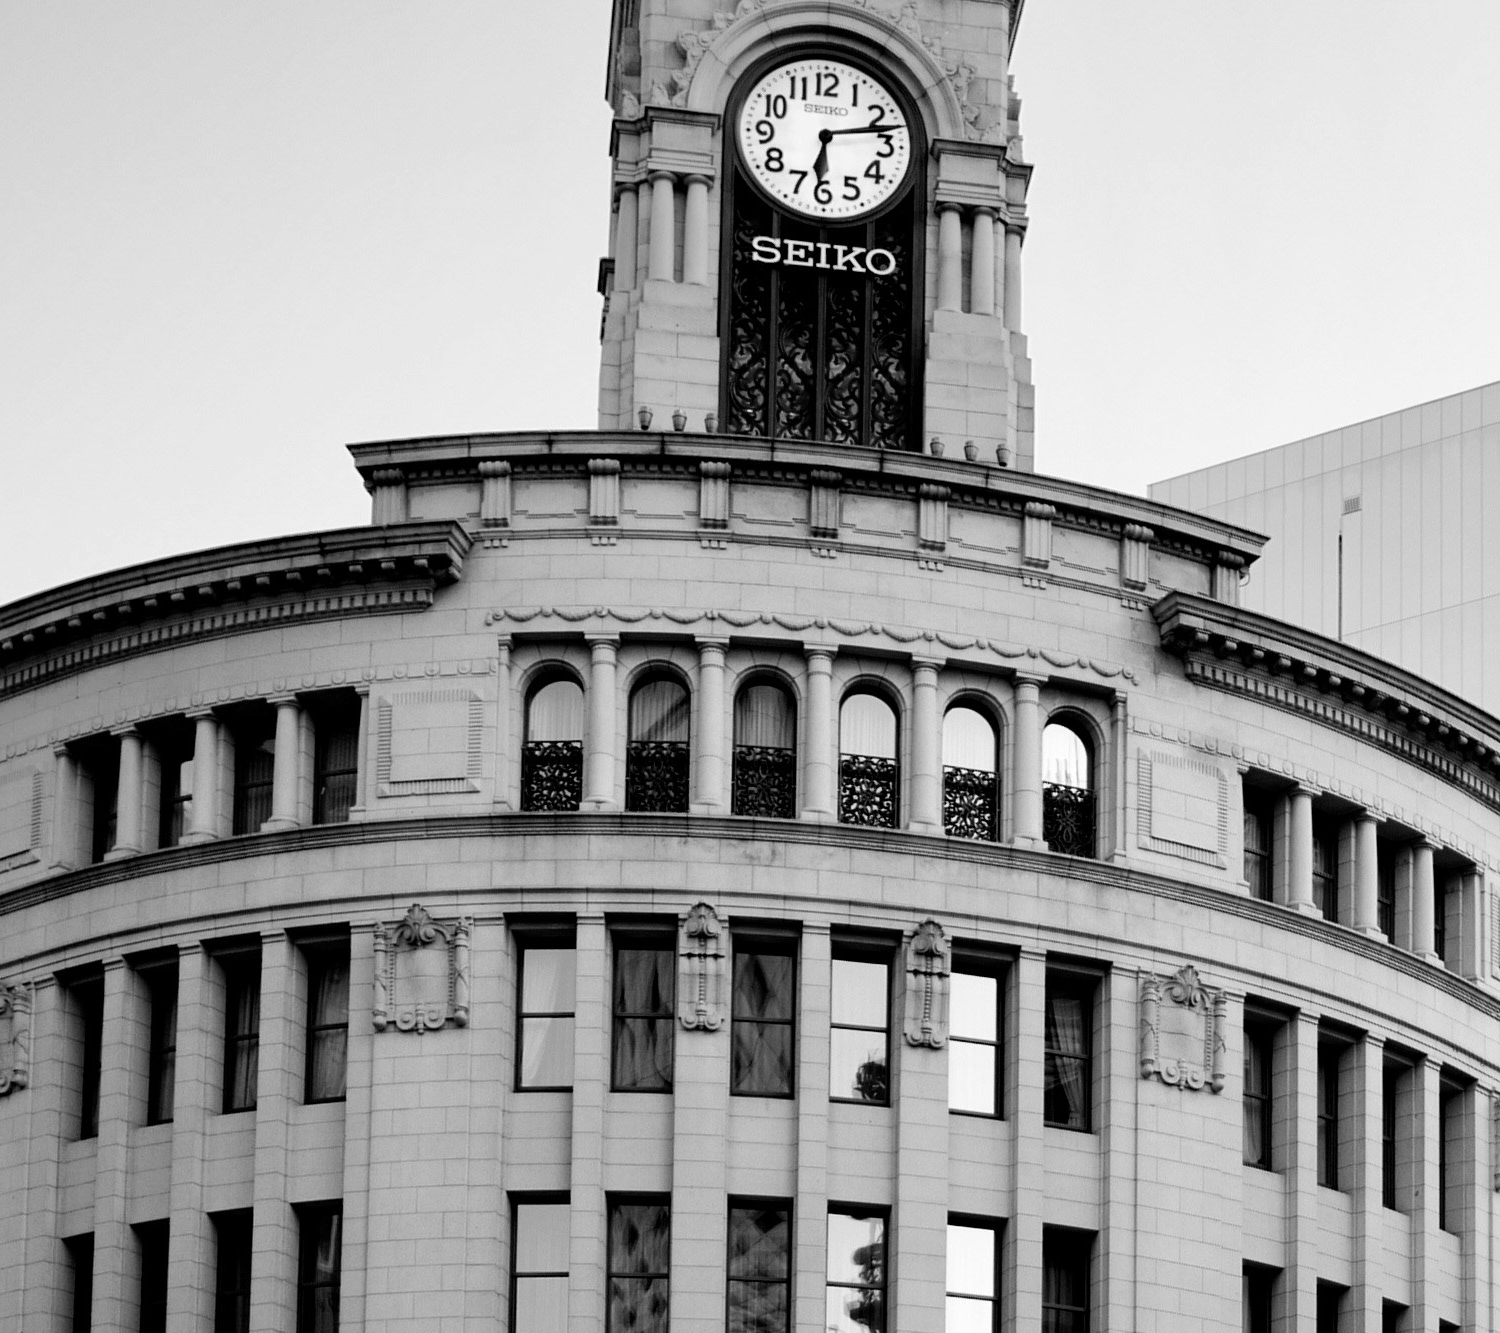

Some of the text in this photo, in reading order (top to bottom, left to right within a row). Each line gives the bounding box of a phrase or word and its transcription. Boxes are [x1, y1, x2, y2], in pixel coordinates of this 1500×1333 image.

[790, 75, 807, 100] 11
[815, 72, 839, 98] 12
[852, 83, 858, 107] 1
[765, 94, 787, 118] 10
[804, 103, 848, 116] SEIKO
[868, 105, 885, 127] 2
[755, 120, 775, 144] 9
[876, 133, 894, 158] 3
[764, 148, 784, 172] 8
[863, 160, 885, 184] 4
[789, 169, 808, 194] 7
[813, 180, 833, 204] 6
[842, 176, 860, 200] 5
[751, 235, 897, 276] SEIKO
